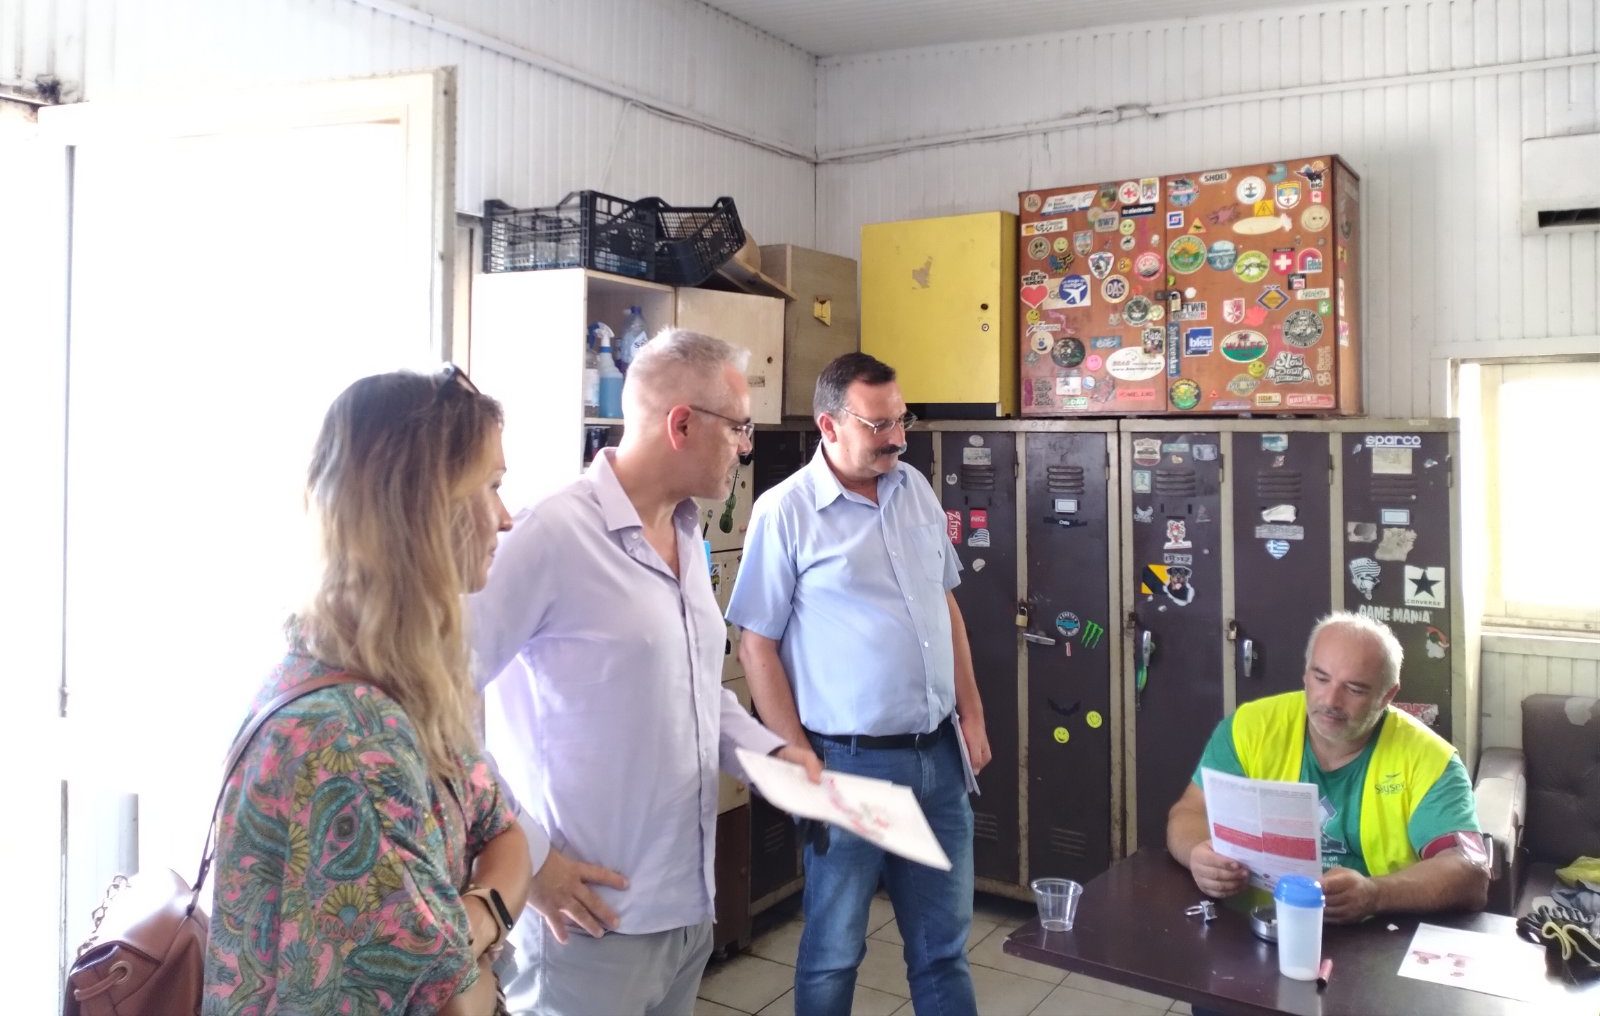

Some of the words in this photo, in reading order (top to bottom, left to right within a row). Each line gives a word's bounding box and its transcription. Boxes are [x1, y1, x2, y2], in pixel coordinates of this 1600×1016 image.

[1204, 172, 1228, 183] SHOEI
[1190, 336, 1212, 348] bleu
[1365, 434, 1421, 446] sparco
[1392, 607, 1431, 623] MANIA
